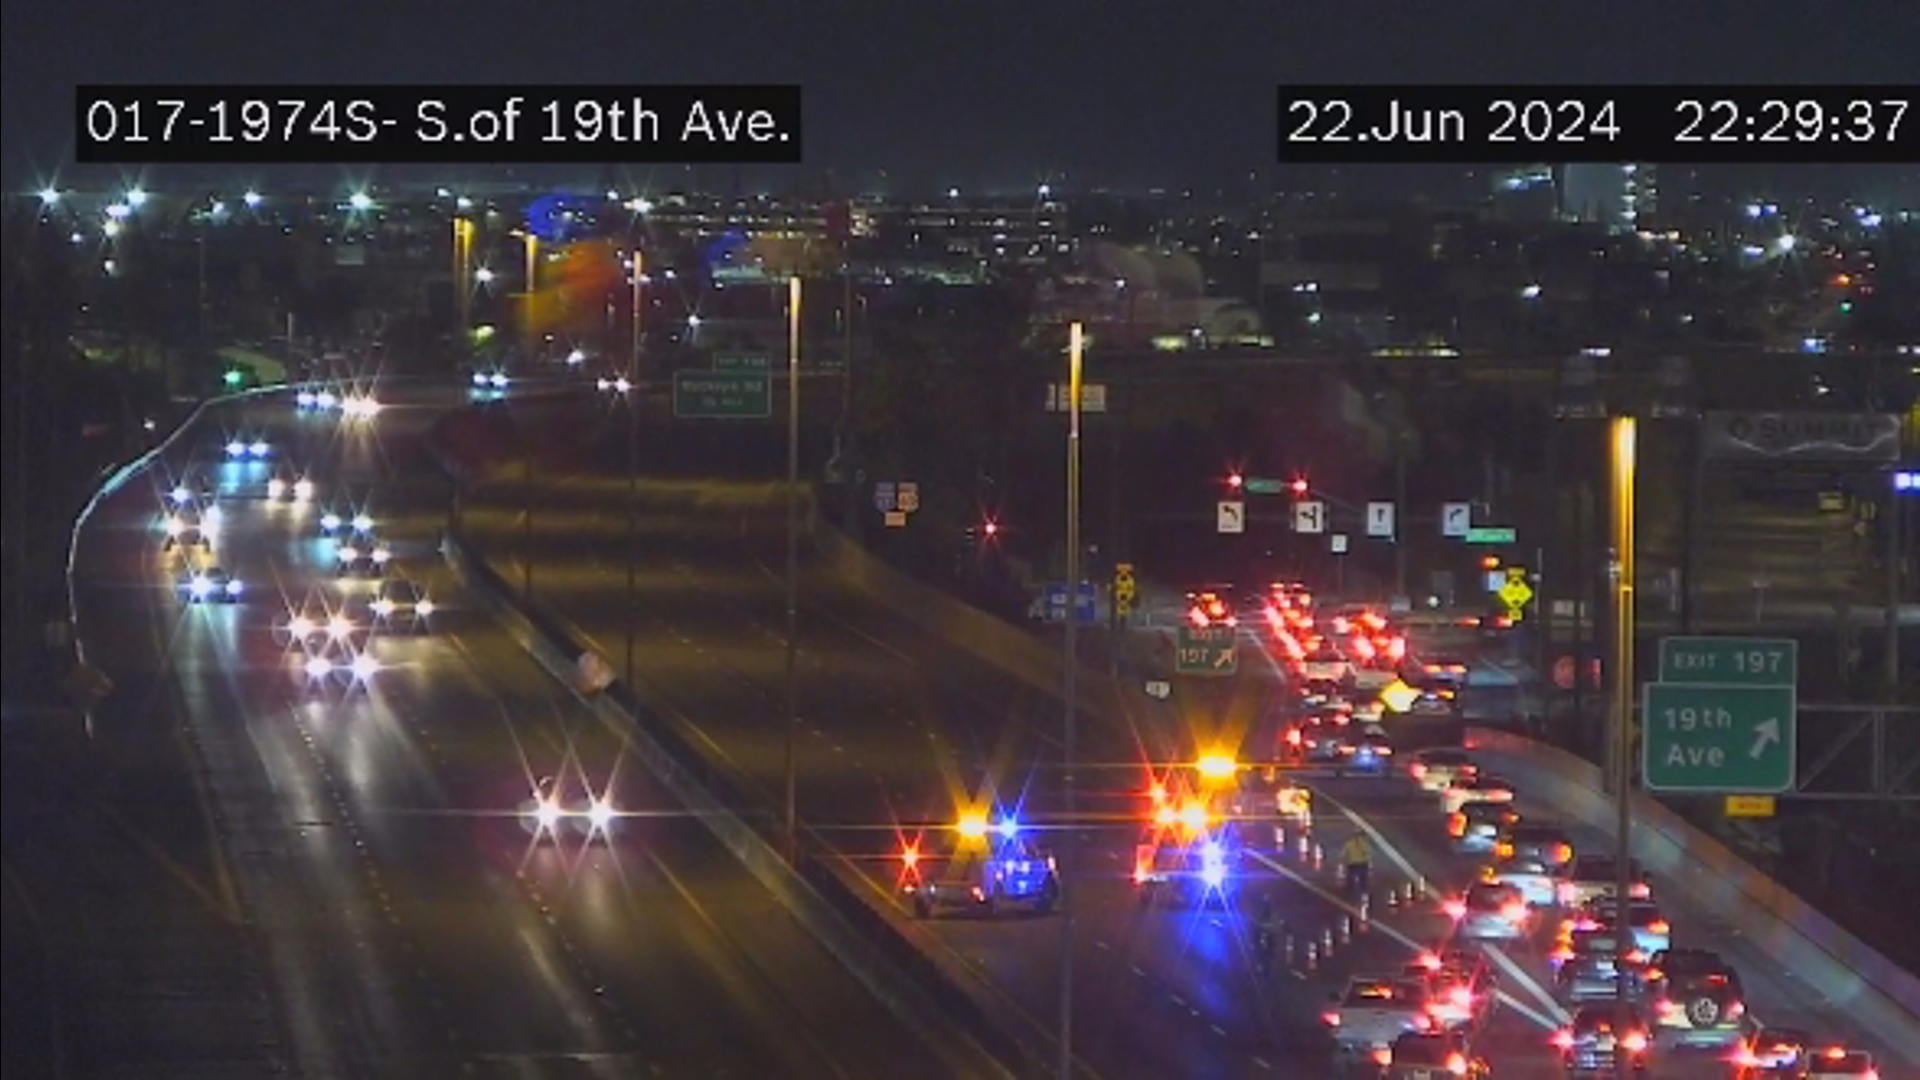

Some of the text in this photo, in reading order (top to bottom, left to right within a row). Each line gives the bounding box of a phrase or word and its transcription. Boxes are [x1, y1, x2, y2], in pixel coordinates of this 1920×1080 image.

[1674, 651, 1783, 673] EXIT 197
[1664, 707, 1732, 731] 19th
[1667, 743, 1725, 767] Ave
